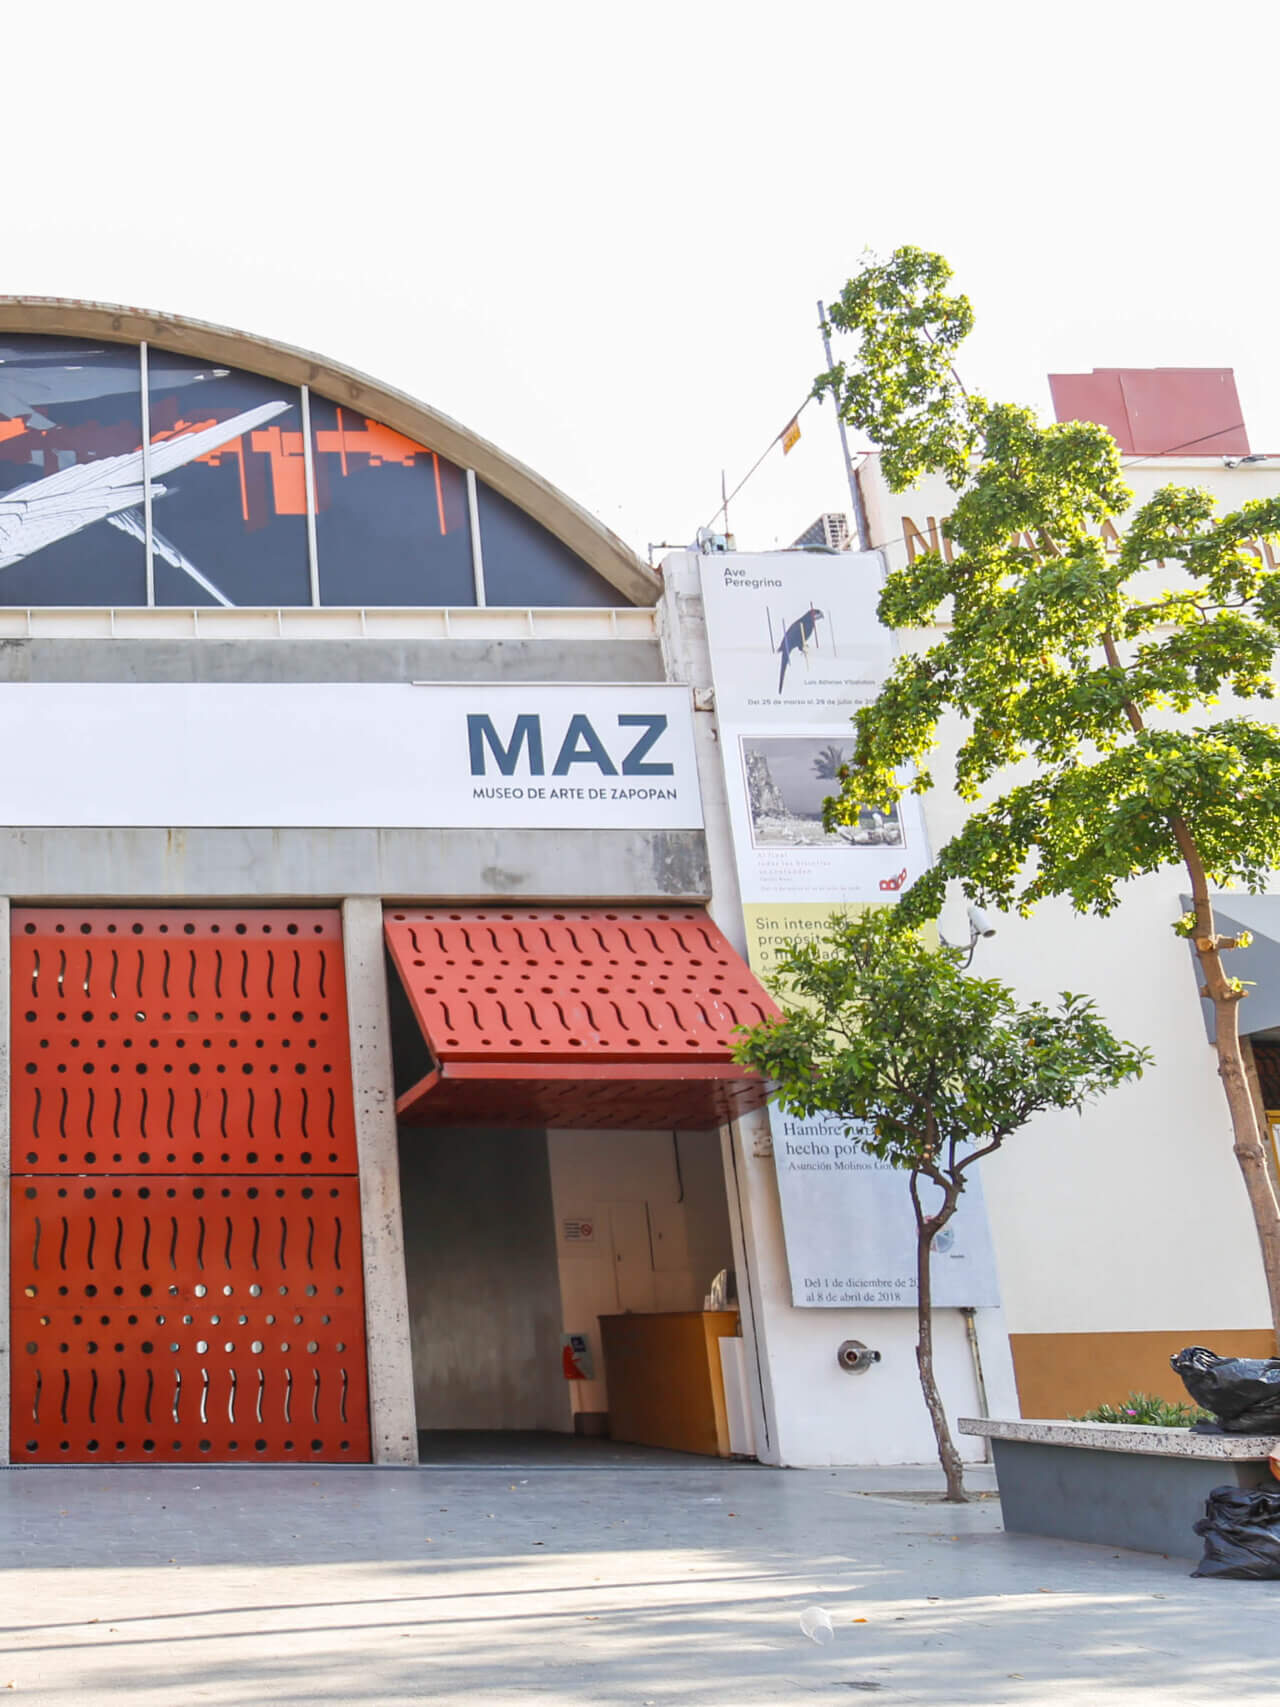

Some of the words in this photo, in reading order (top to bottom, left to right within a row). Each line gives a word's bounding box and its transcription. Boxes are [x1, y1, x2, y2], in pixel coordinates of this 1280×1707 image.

[724, 567, 746, 577] Ave
[725, 577, 783, 589] Peregrina
[466, 713, 675, 776] MAZ
[472, 787, 524, 799] MUSEO
[527, 787, 546, 799] DE
[550, 787, 585, 799] ARTE
[588, 787, 608, 800] DE
[610, 788, 677, 800] ZAPOPAN
[756, 917, 779, 930] Sin
[759, 933, 829, 946] propósit
[784, 1122, 840, 1136] Hambre
[786, 1141, 830, 1155] hecho
[834, 1144, 857, 1158] por
[789, 1161, 832, 1170] Asunción
[834, 1161, 872, 1170] Molinos
[804, 1278, 821, 1288] Del
[832, 1278, 844, 1288] de
[846, 1278, 893, 1288] diciembre
[894, 1278, 907, 1288] de
[806, 1292, 815, 1302] al
[825, 1292, 837, 1302] de
[840, 1292, 861, 1302] abril
[863, 1292, 875, 1302] de
